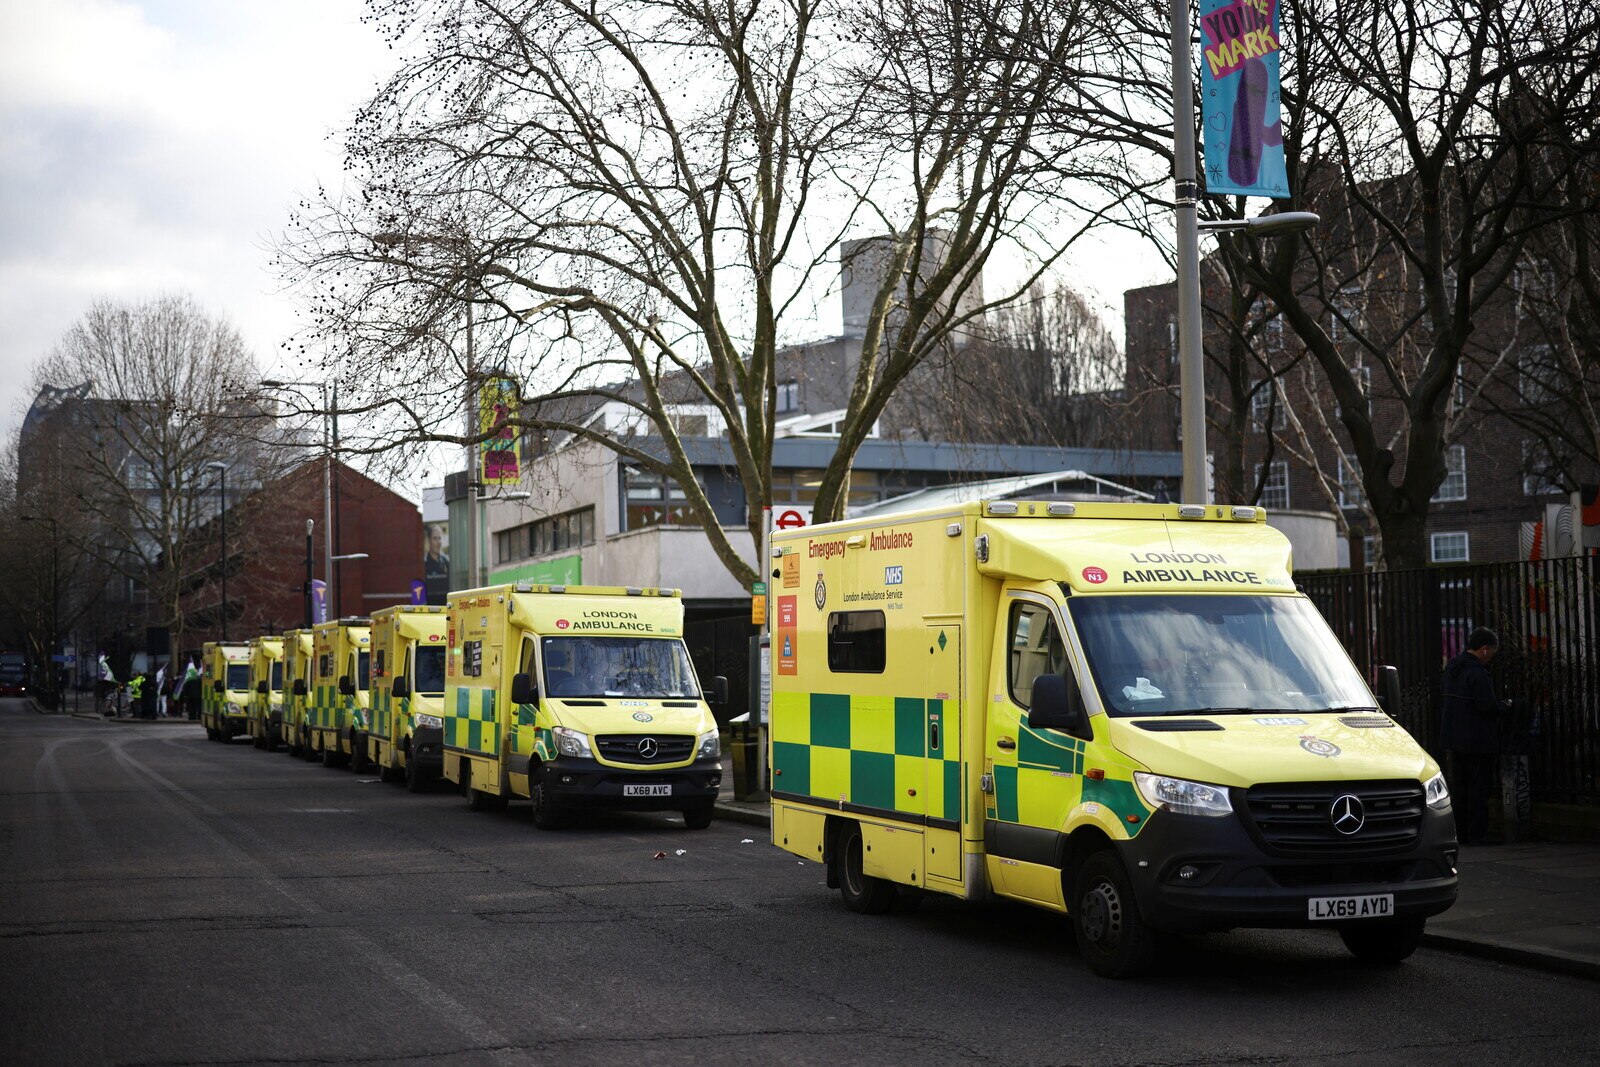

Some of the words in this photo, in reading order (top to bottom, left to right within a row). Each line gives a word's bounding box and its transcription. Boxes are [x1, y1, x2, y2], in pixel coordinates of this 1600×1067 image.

[1206, 5, 1267, 43] YOUR
[1205, 25, 1279, 75] MARK
[808, 539, 846, 560] Emergency
[870, 529, 913, 551] Ambulance
[1130, 552, 1227, 564] LONDON
[885, 567, 902, 584] NHS
[1088, 573, 1103, 581] N1
[1123, 569, 1262, 584] AMBULANCE
[843, 592, 859, 602] London
[861, 590, 885, 601] Ambulance
[886, 589, 903, 599] Service
[583, 611, 638, 619] LONDON
[573, 621, 654, 632] AMBULANCE
[1256, 717, 1306, 726] NHS
[626, 785, 650, 795] LX68
[652, 785, 669, 795] AVC
[1315, 900, 1356, 917] LX69
[1361, 898, 1388, 915] AYD
